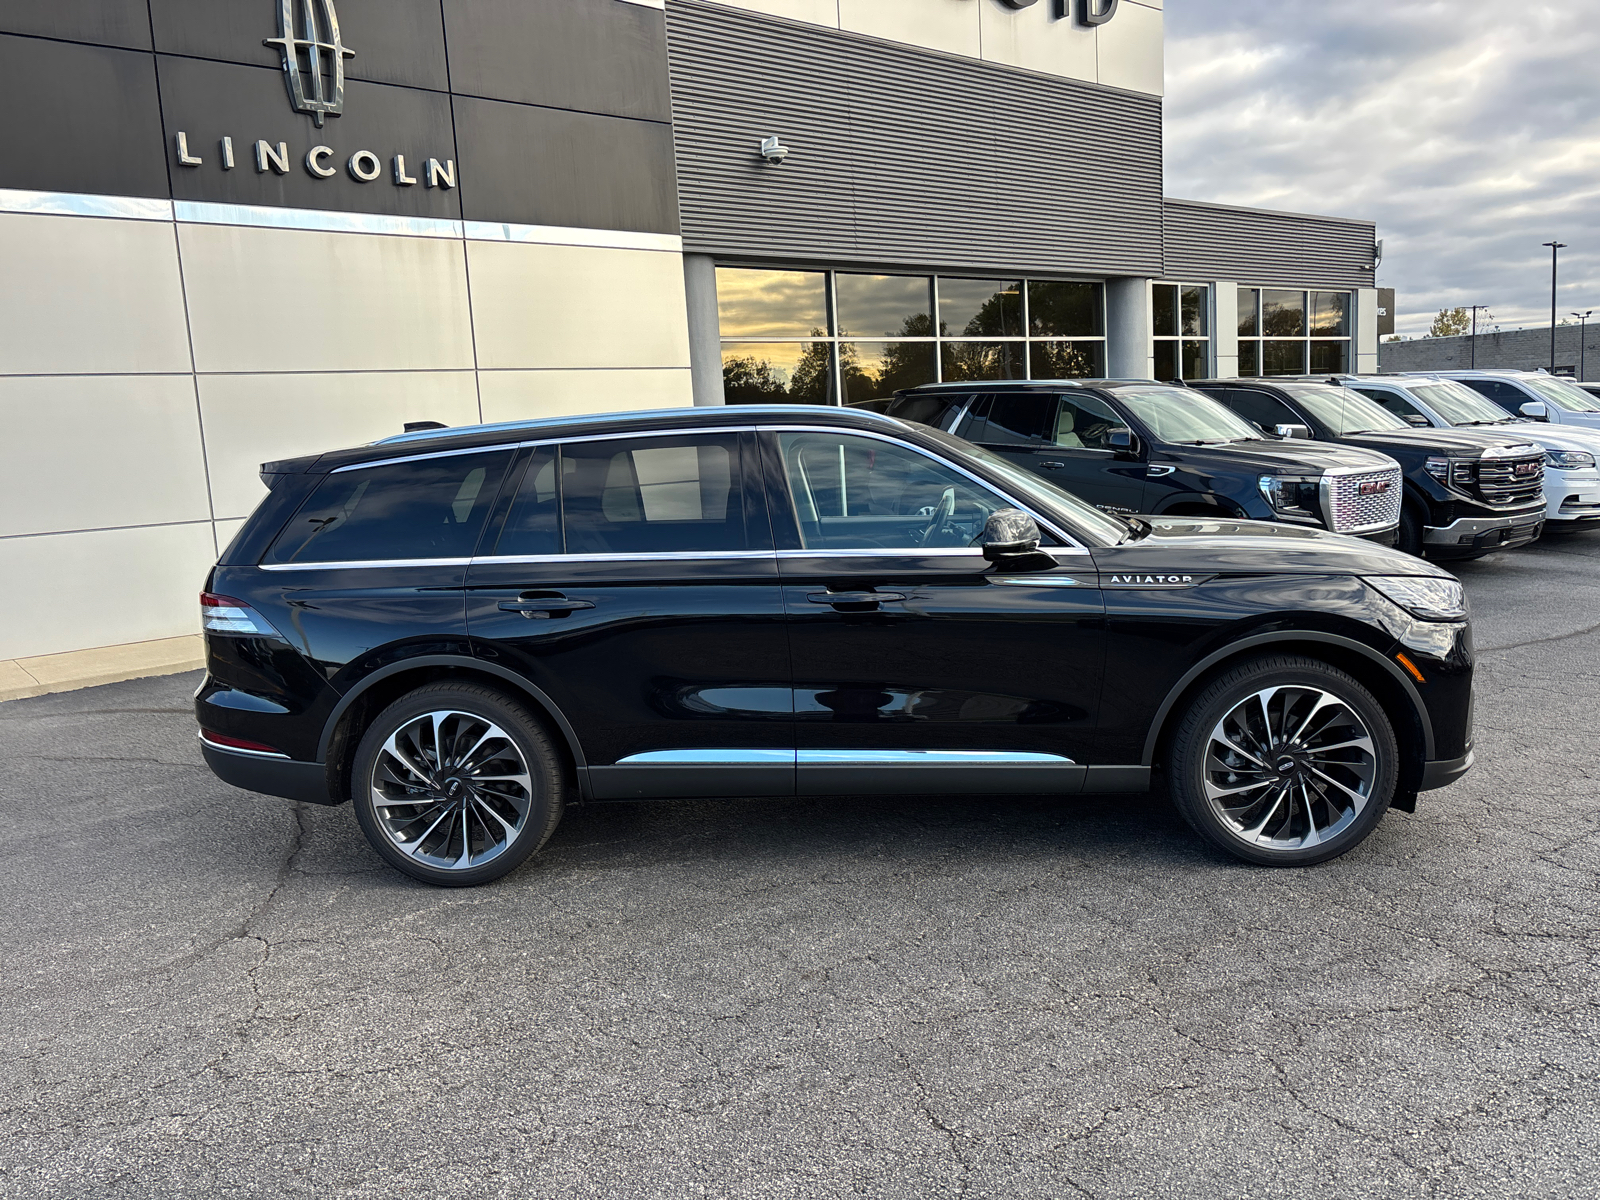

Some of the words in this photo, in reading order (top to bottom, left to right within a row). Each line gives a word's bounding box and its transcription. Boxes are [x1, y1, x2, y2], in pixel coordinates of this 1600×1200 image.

[176, 131, 456, 188] LINCOLN
[1360, 481, 1390, 494] GMC
[1096, 504, 1139, 513] DENALI
[1111, 575, 1192, 583] AVIATOR
